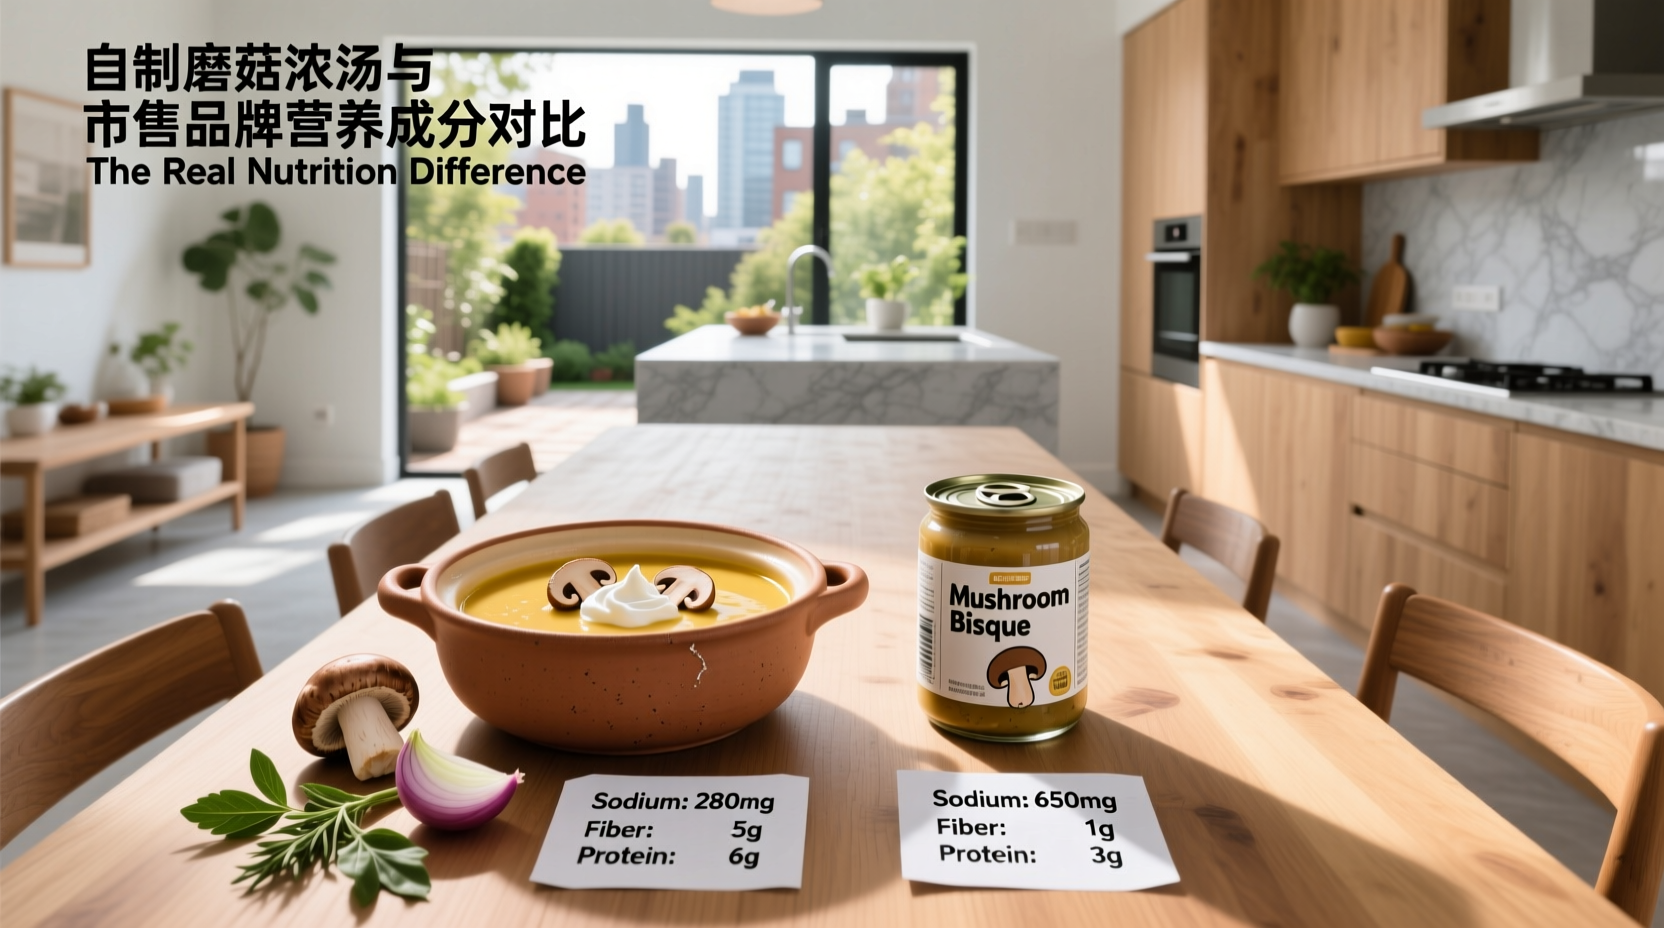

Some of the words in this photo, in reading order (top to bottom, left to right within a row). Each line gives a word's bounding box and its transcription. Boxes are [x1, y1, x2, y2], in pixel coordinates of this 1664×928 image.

[949, 583, 1070, 611] Mushroom
[950, 610, 1031, 642] Bisque
[591, 791, 689, 811] Sodium:
[693, 791, 775, 815] 280mg
[932, 789, 1029, 809] Sodium:
[1034, 790, 1118, 814] 650mg
[584, 819, 654, 839] Fiber:
[731, 820, 763, 843] 5g
[937, 817, 1006, 837] Fiber:
[1085, 818, 1115, 842] 1g
[576, 846, 676, 866] Protein:
[728, 847, 760, 870] 6g
[939, 844, 1037, 864] Protein:
[1090, 846, 1123, 869] 3g
